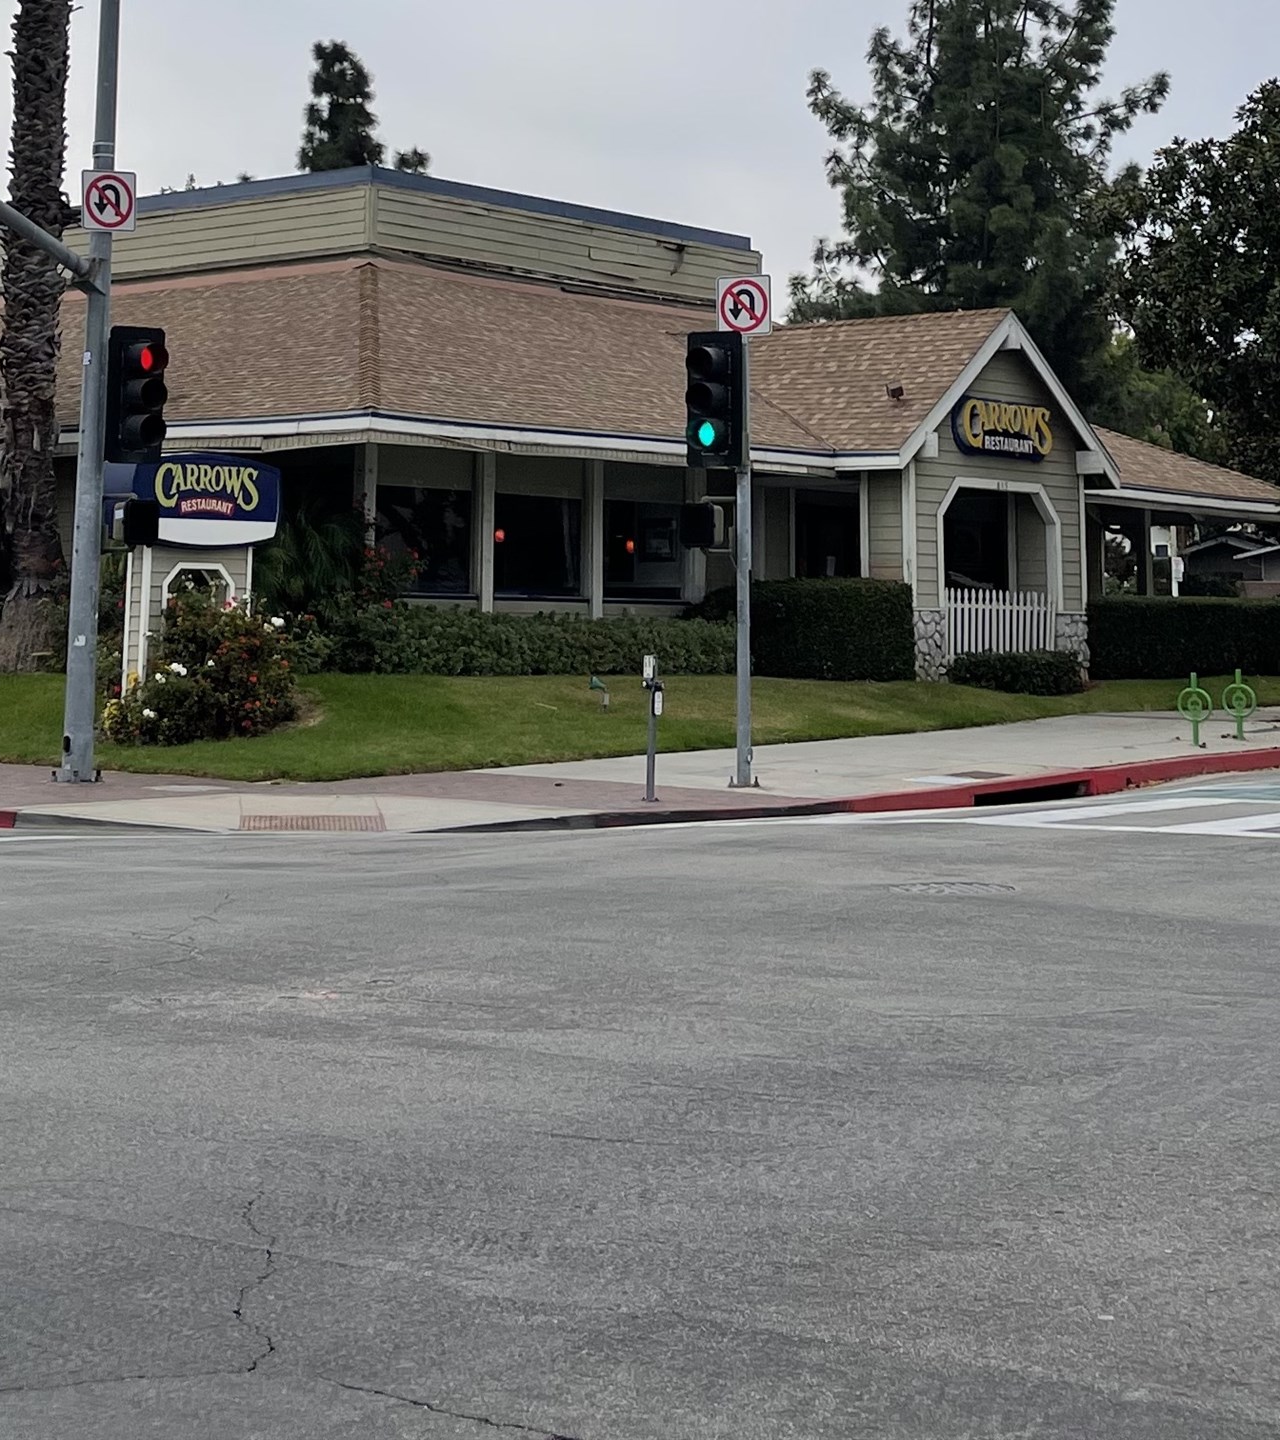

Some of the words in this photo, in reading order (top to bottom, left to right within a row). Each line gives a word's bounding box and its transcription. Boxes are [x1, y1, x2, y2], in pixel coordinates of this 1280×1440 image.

[963, 398, 1053, 455] CARROWS
[984, 435, 1034, 454] RESTAURANT
[154, 462, 260, 511] CARROWS
[181, 498, 234, 516] RESTAURANT
